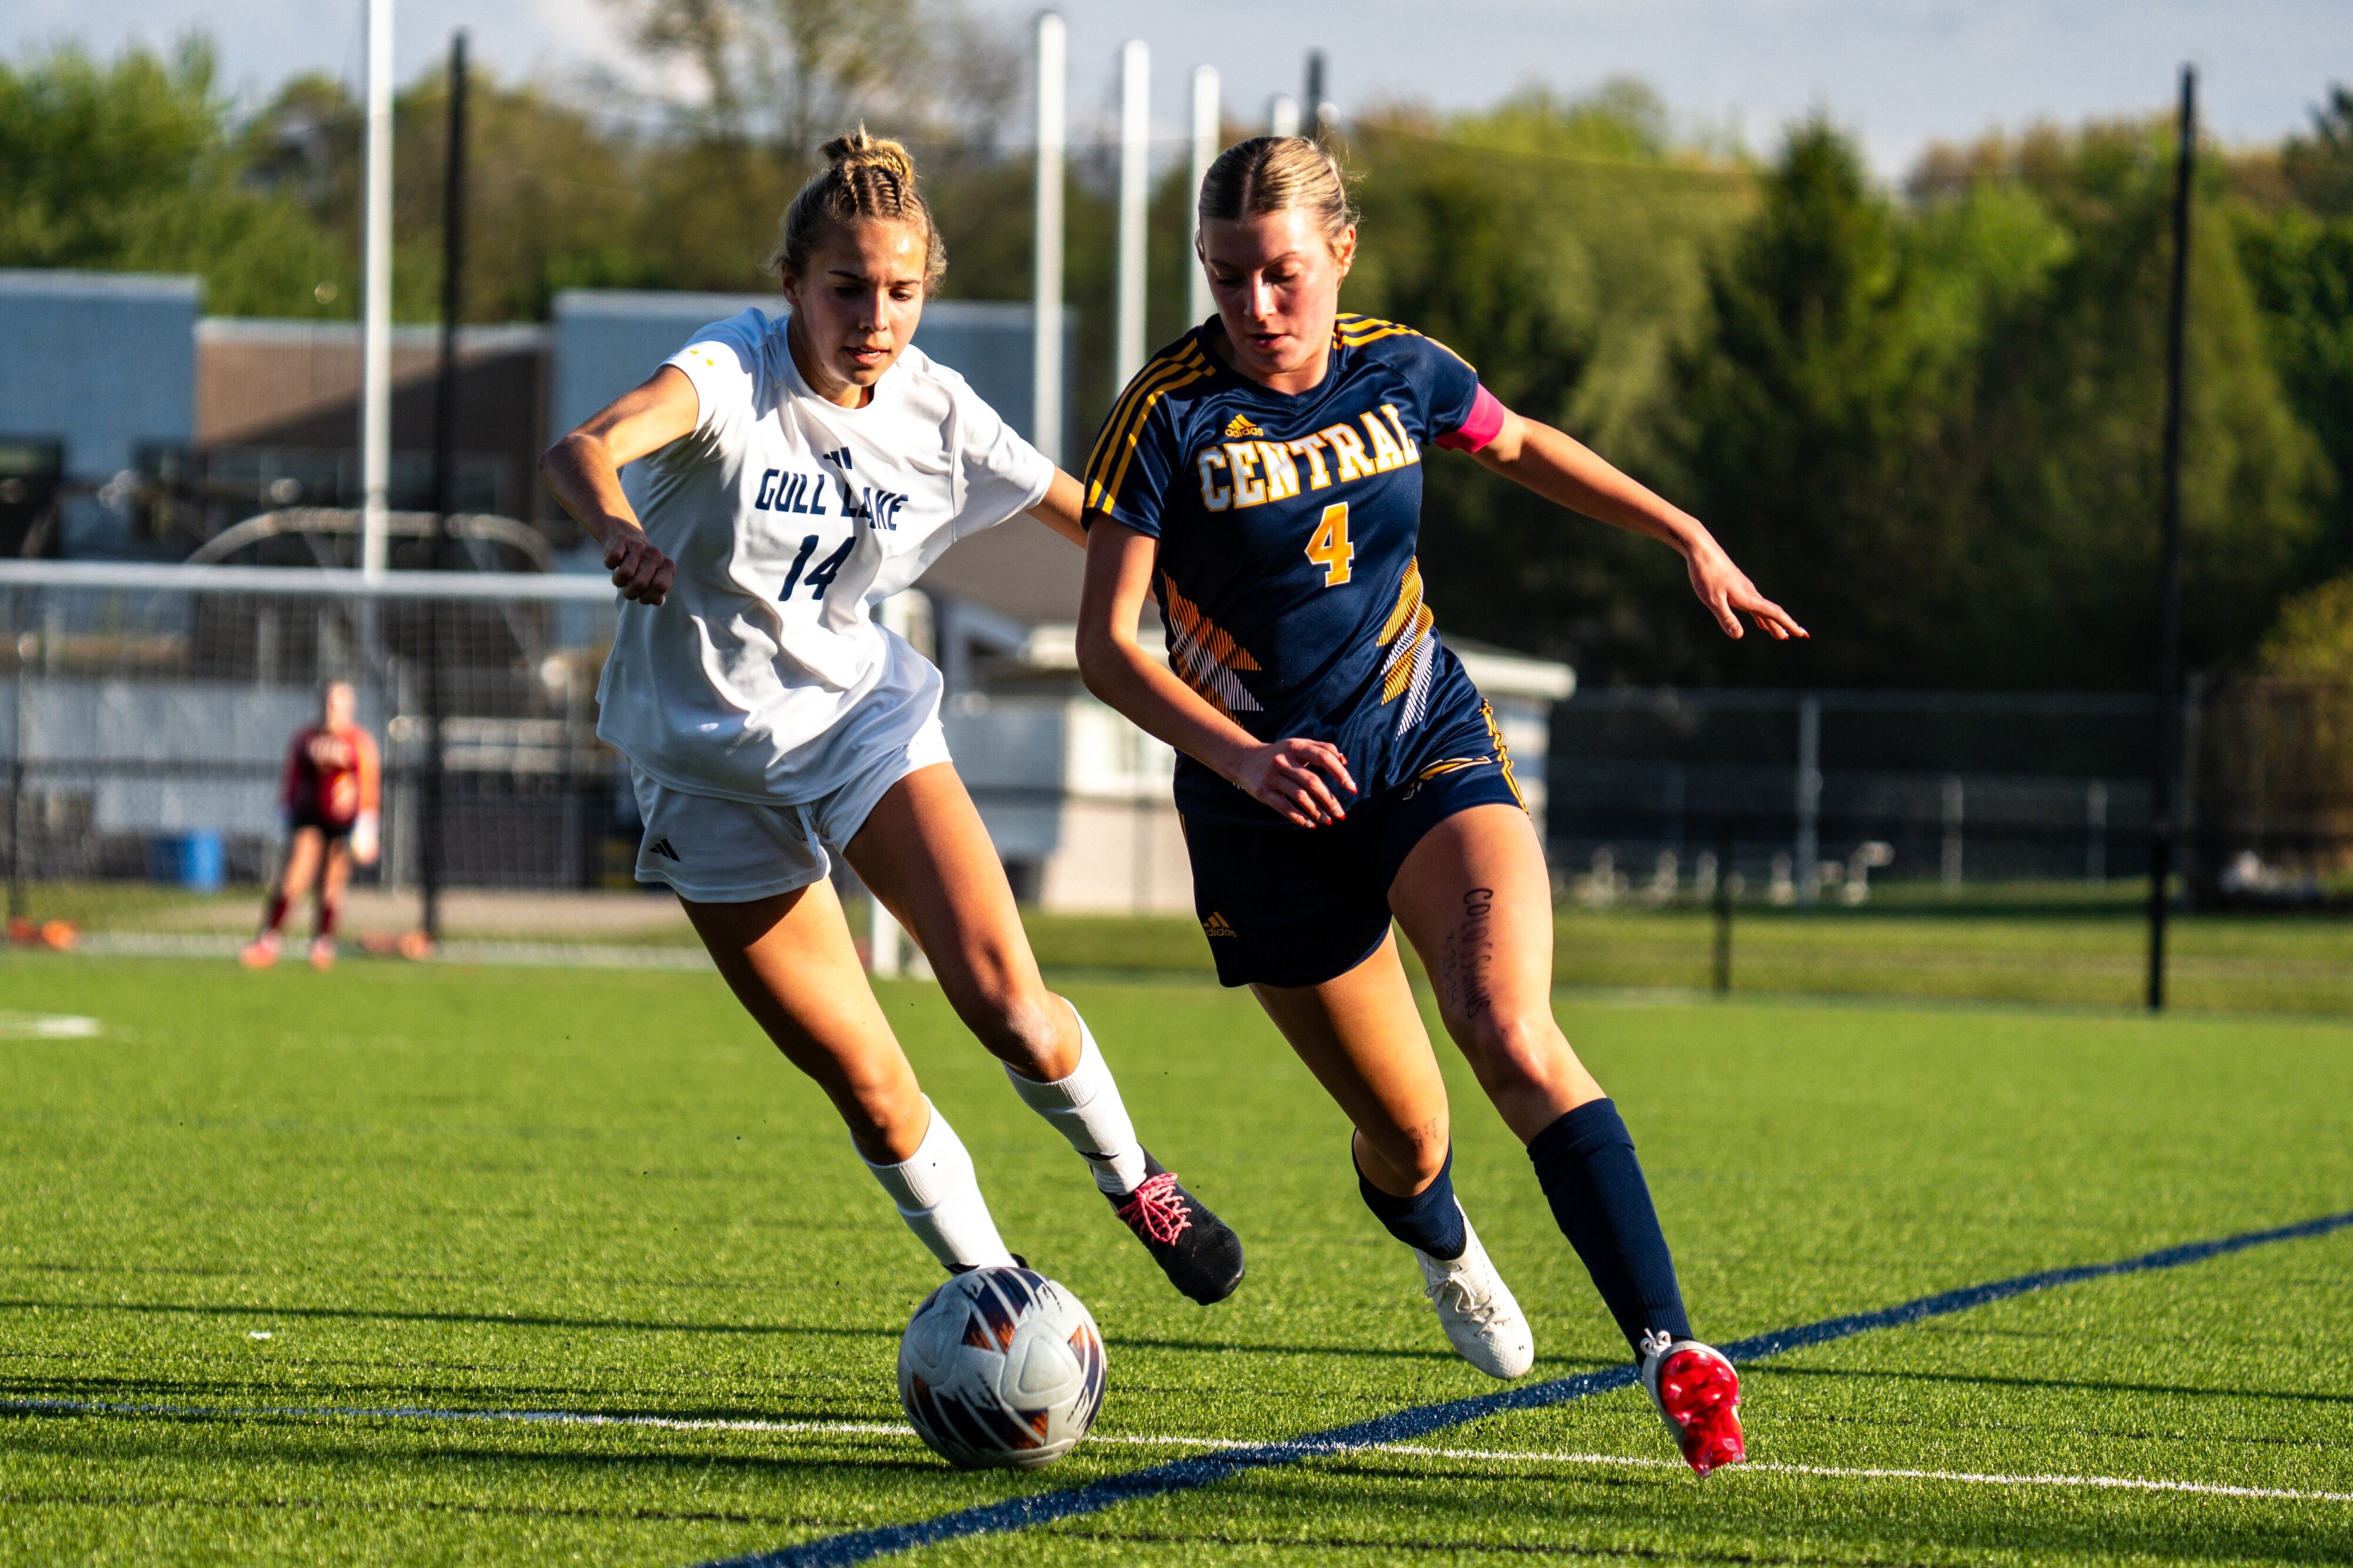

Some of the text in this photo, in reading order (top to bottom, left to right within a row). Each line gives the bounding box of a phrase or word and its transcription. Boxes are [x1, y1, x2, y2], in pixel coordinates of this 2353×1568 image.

[1197, 403, 1421, 512] CENTRAL
[1225, 427, 1264, 438] adidas
[755, 468, 909, 531] GULL LAKE
[778, 534, 857, 602] 14
[1304, 501, 1355, 587] 4
[1205, 926, 1237, 938] didas
